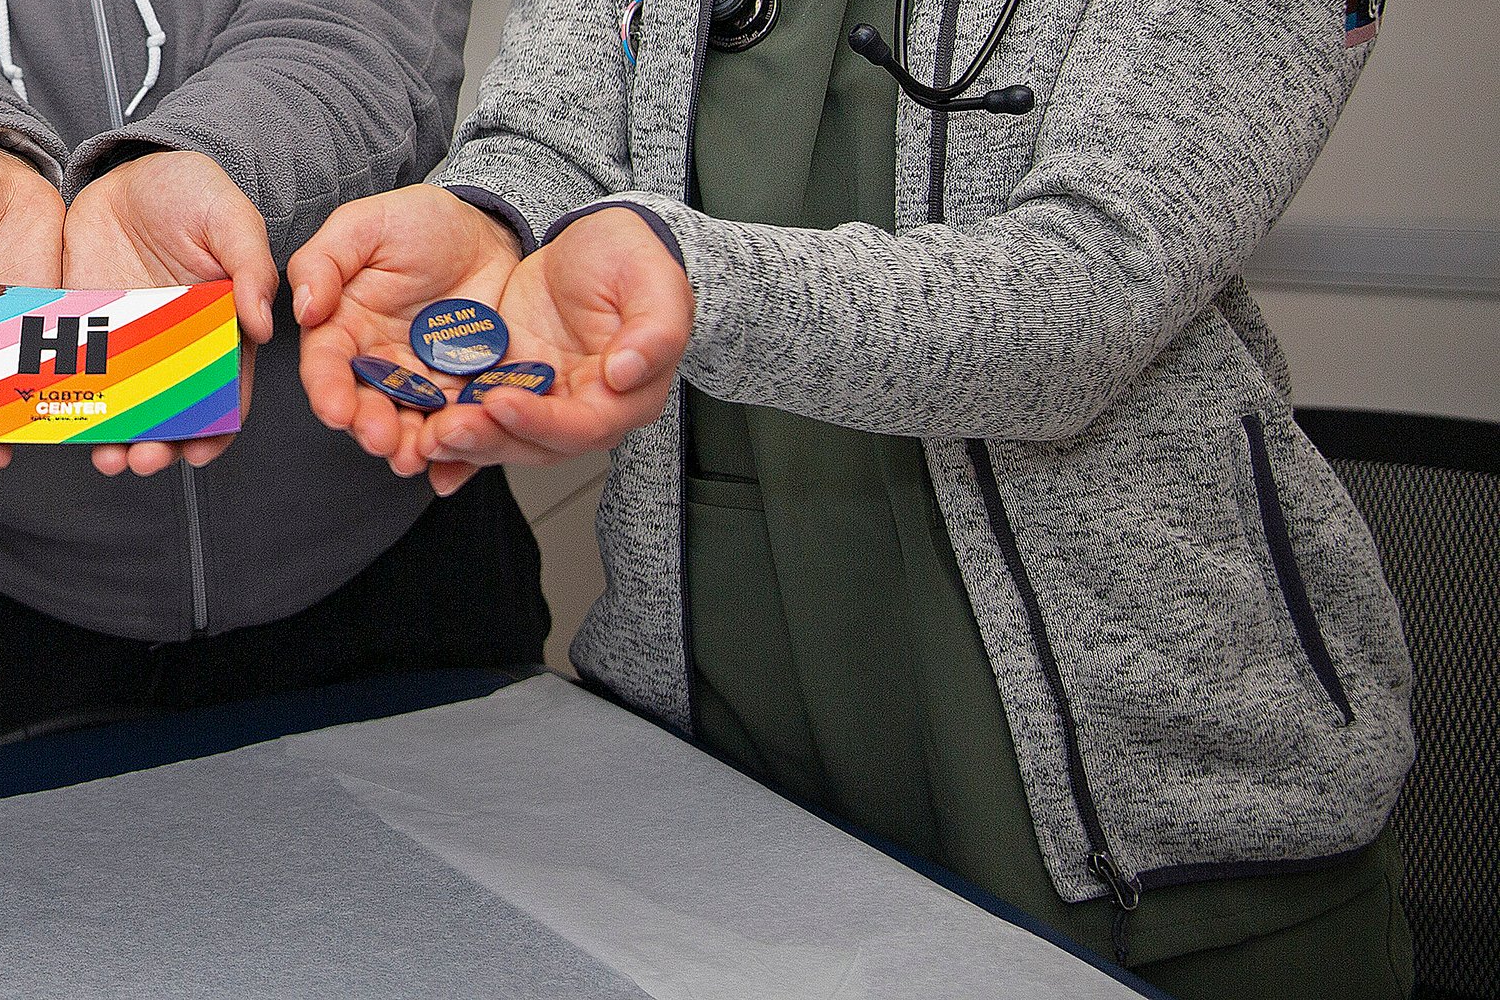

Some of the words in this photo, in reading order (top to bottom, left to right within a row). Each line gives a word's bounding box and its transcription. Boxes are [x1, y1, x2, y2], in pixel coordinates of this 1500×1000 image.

[428, 312, 456, 329] ASK
[455, 307, 477, 322] MY
[422, 318, 496, 346] PRONOUNS
[17, 316, 109, 375] Hi
[39, 390, 104, 401] LGBTQ+
[35, 401, 107, 415] CENTER
